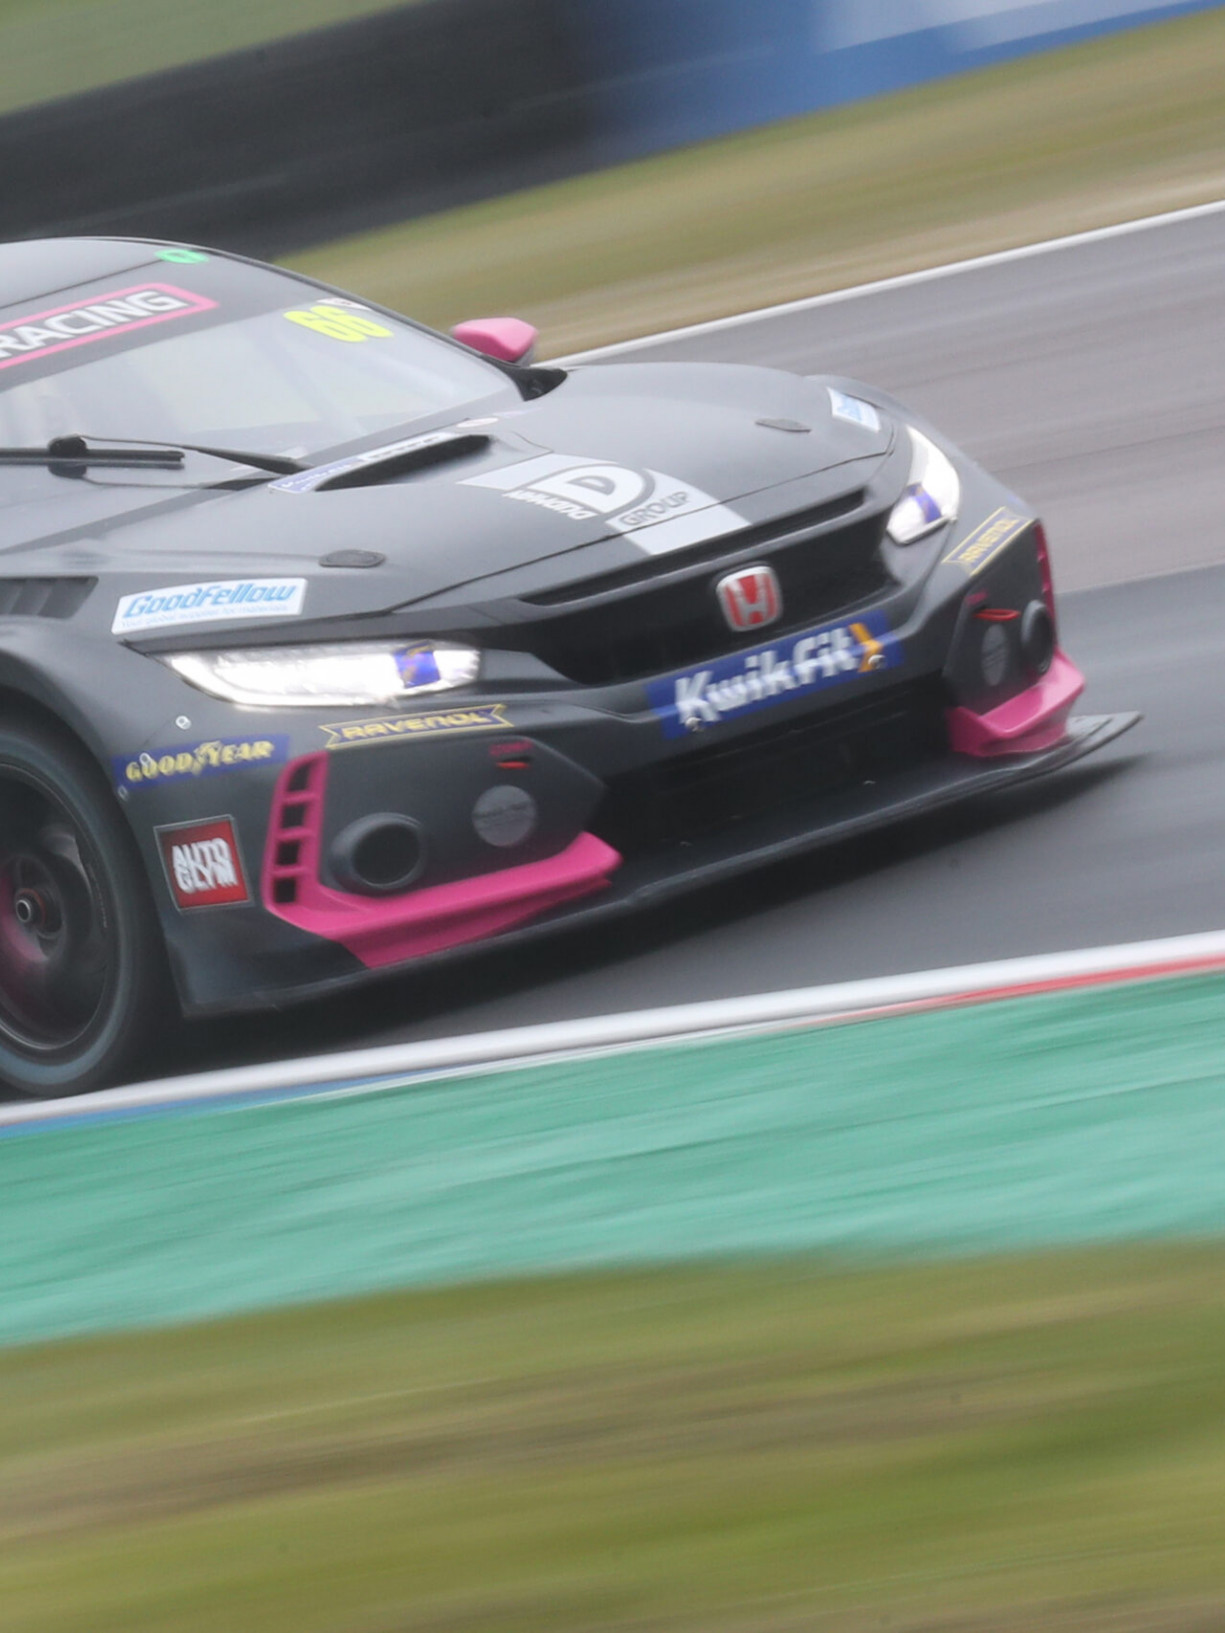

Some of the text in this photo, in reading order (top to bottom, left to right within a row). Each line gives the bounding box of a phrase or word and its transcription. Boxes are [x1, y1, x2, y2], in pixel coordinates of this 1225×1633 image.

[282, 305, 394, 342] 66
[618, 491, 689, 526] GROUP
[675, 651, 799, 724] Kwik
[341, 711, 493, 740] RAVENOL
[172, 837, 230, 868] AUTO
